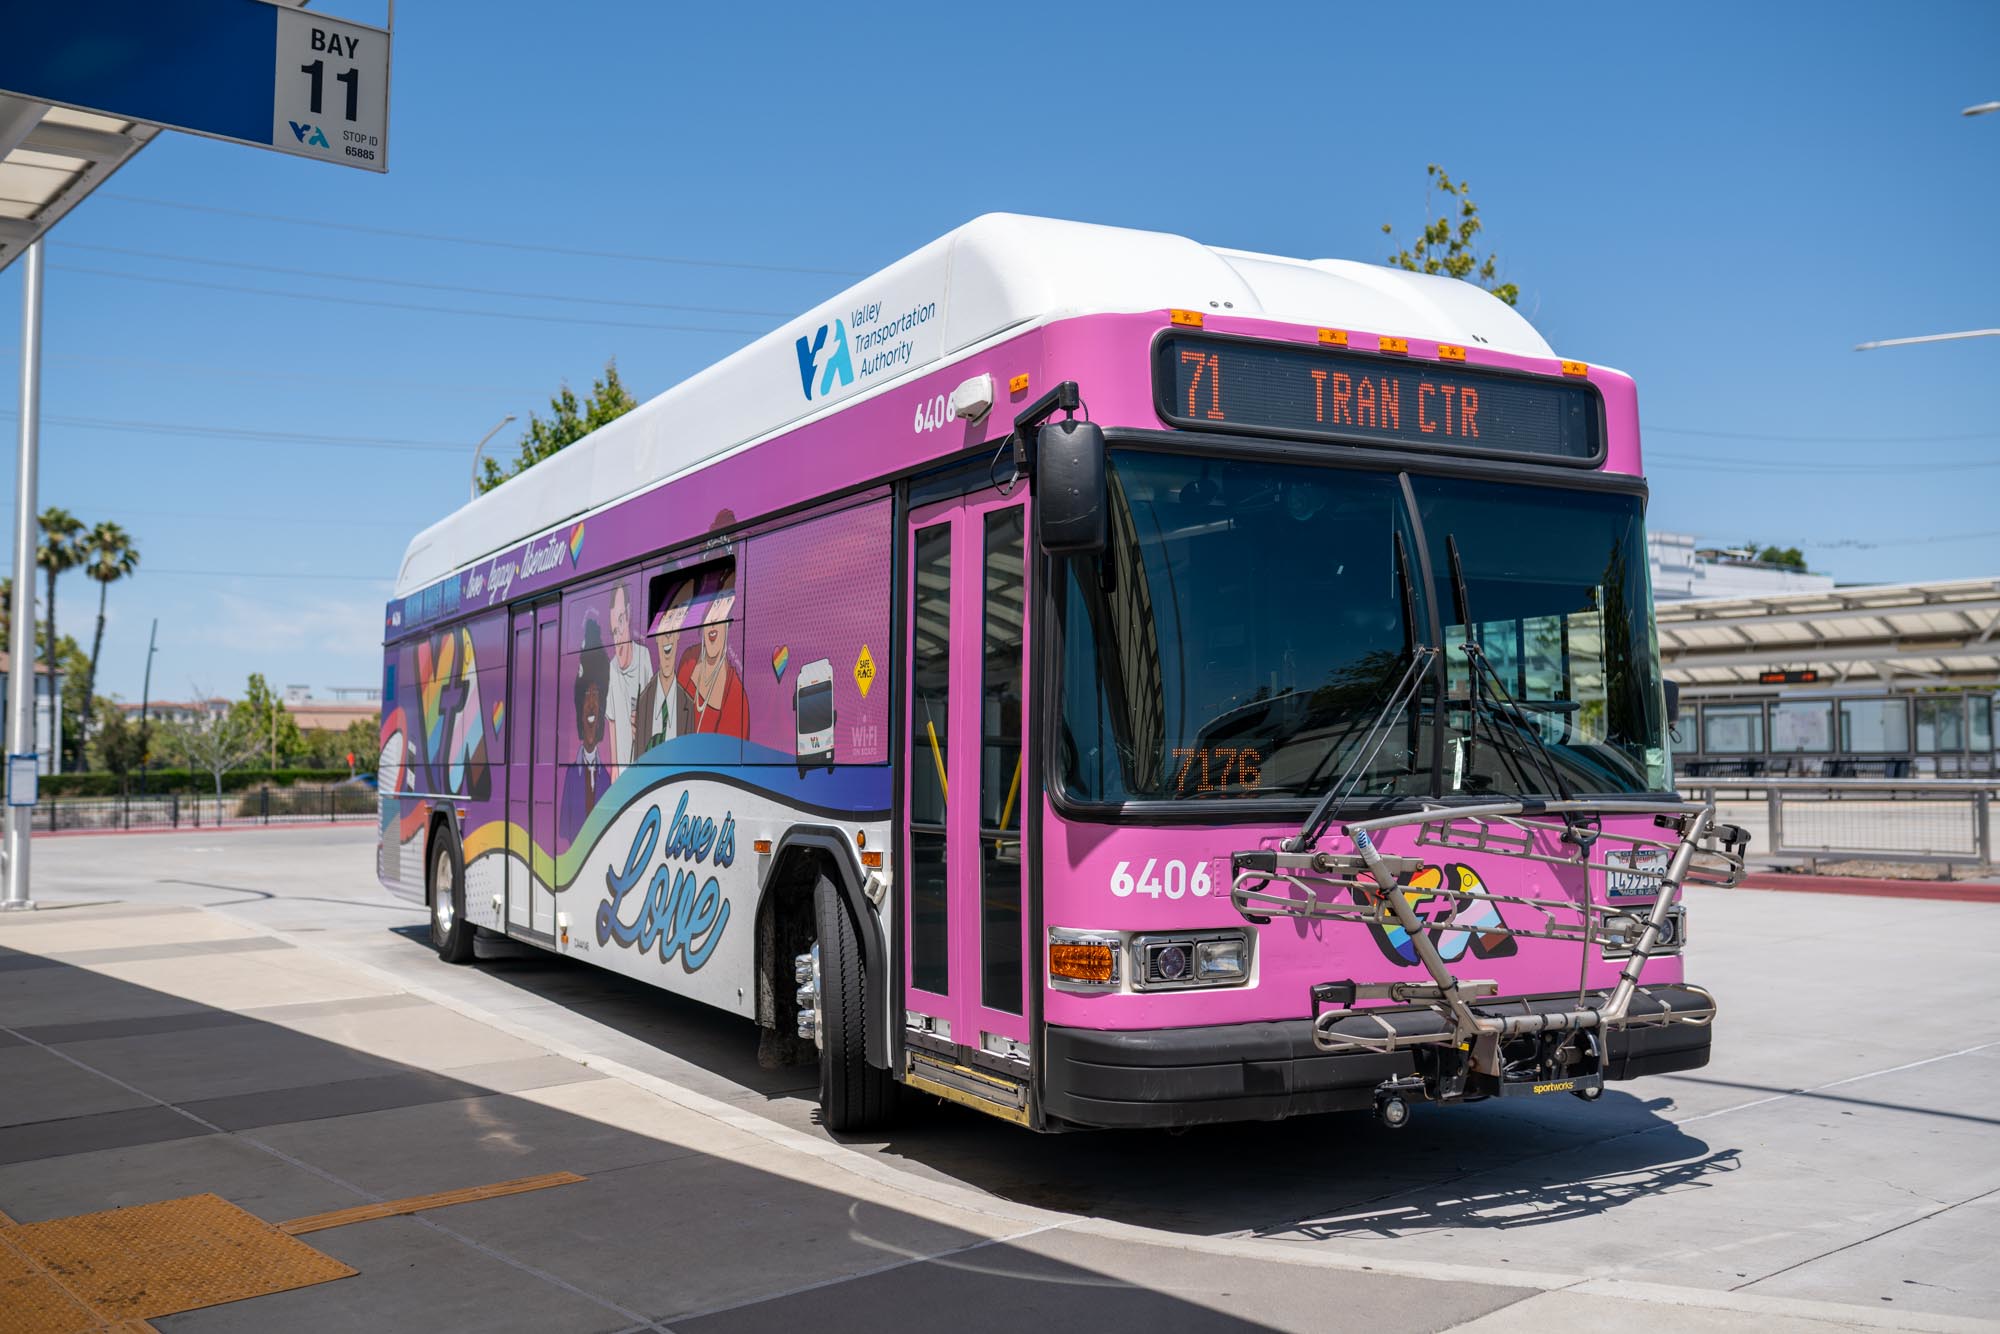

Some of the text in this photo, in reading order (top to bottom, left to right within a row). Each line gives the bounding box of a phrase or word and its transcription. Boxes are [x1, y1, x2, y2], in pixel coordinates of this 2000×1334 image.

[311, 28, 360, 59] BAY
[301, 59, 359, 122] 11
[343, 130, 378, 146] STOP ID
[345, 145, 375, 160] 65885
[851, 301, 882, 329] Valley
[855, 302, 936, 354] Transportation
[859, 340, 914, 379] Authority
[1181, 351, 1225, 421] 71
[1311, 369, 1480, 438] TRAN CTR
[914, 391, 956, 434] 6406
[859, 659, 870, 669] SAFE
[1172, 748, 1261, 791] 7176
[665, 789, 736, 869] love is
[596, 804, 731, 975] Love
[1110, 858, 1212, 900] 6406
[1533, 1081, 1574, 1095] sportworks
